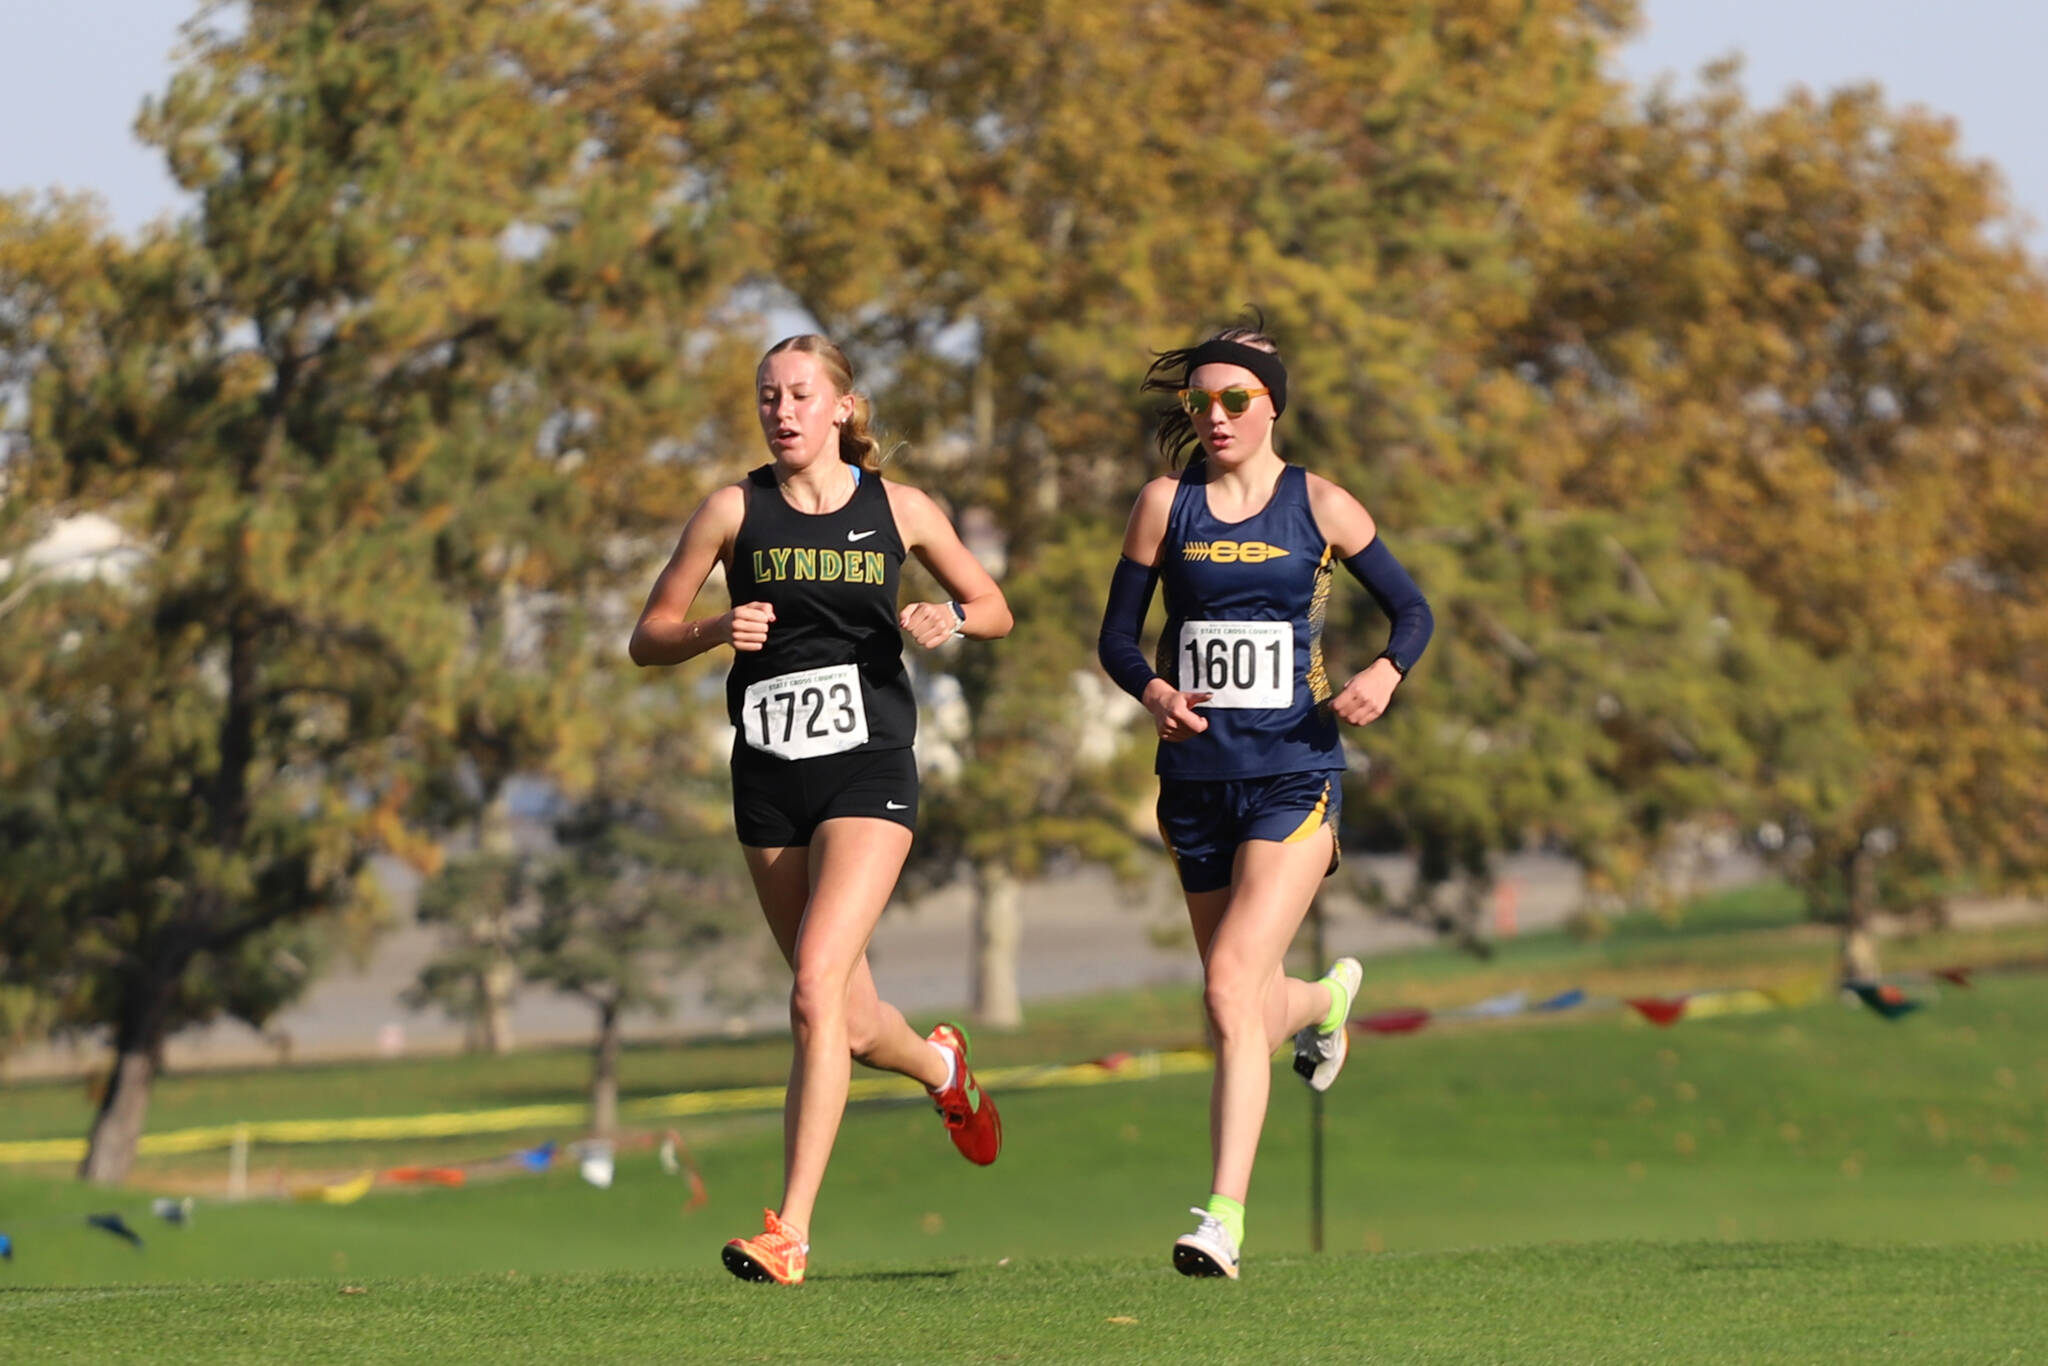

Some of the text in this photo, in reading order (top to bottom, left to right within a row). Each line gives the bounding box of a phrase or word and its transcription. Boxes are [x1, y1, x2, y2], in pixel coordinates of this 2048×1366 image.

[753, 547, 885, 585] LYNDEN
[1184, 638, 1280, 690] 1601
[752, 683, 857, 746] 1723
